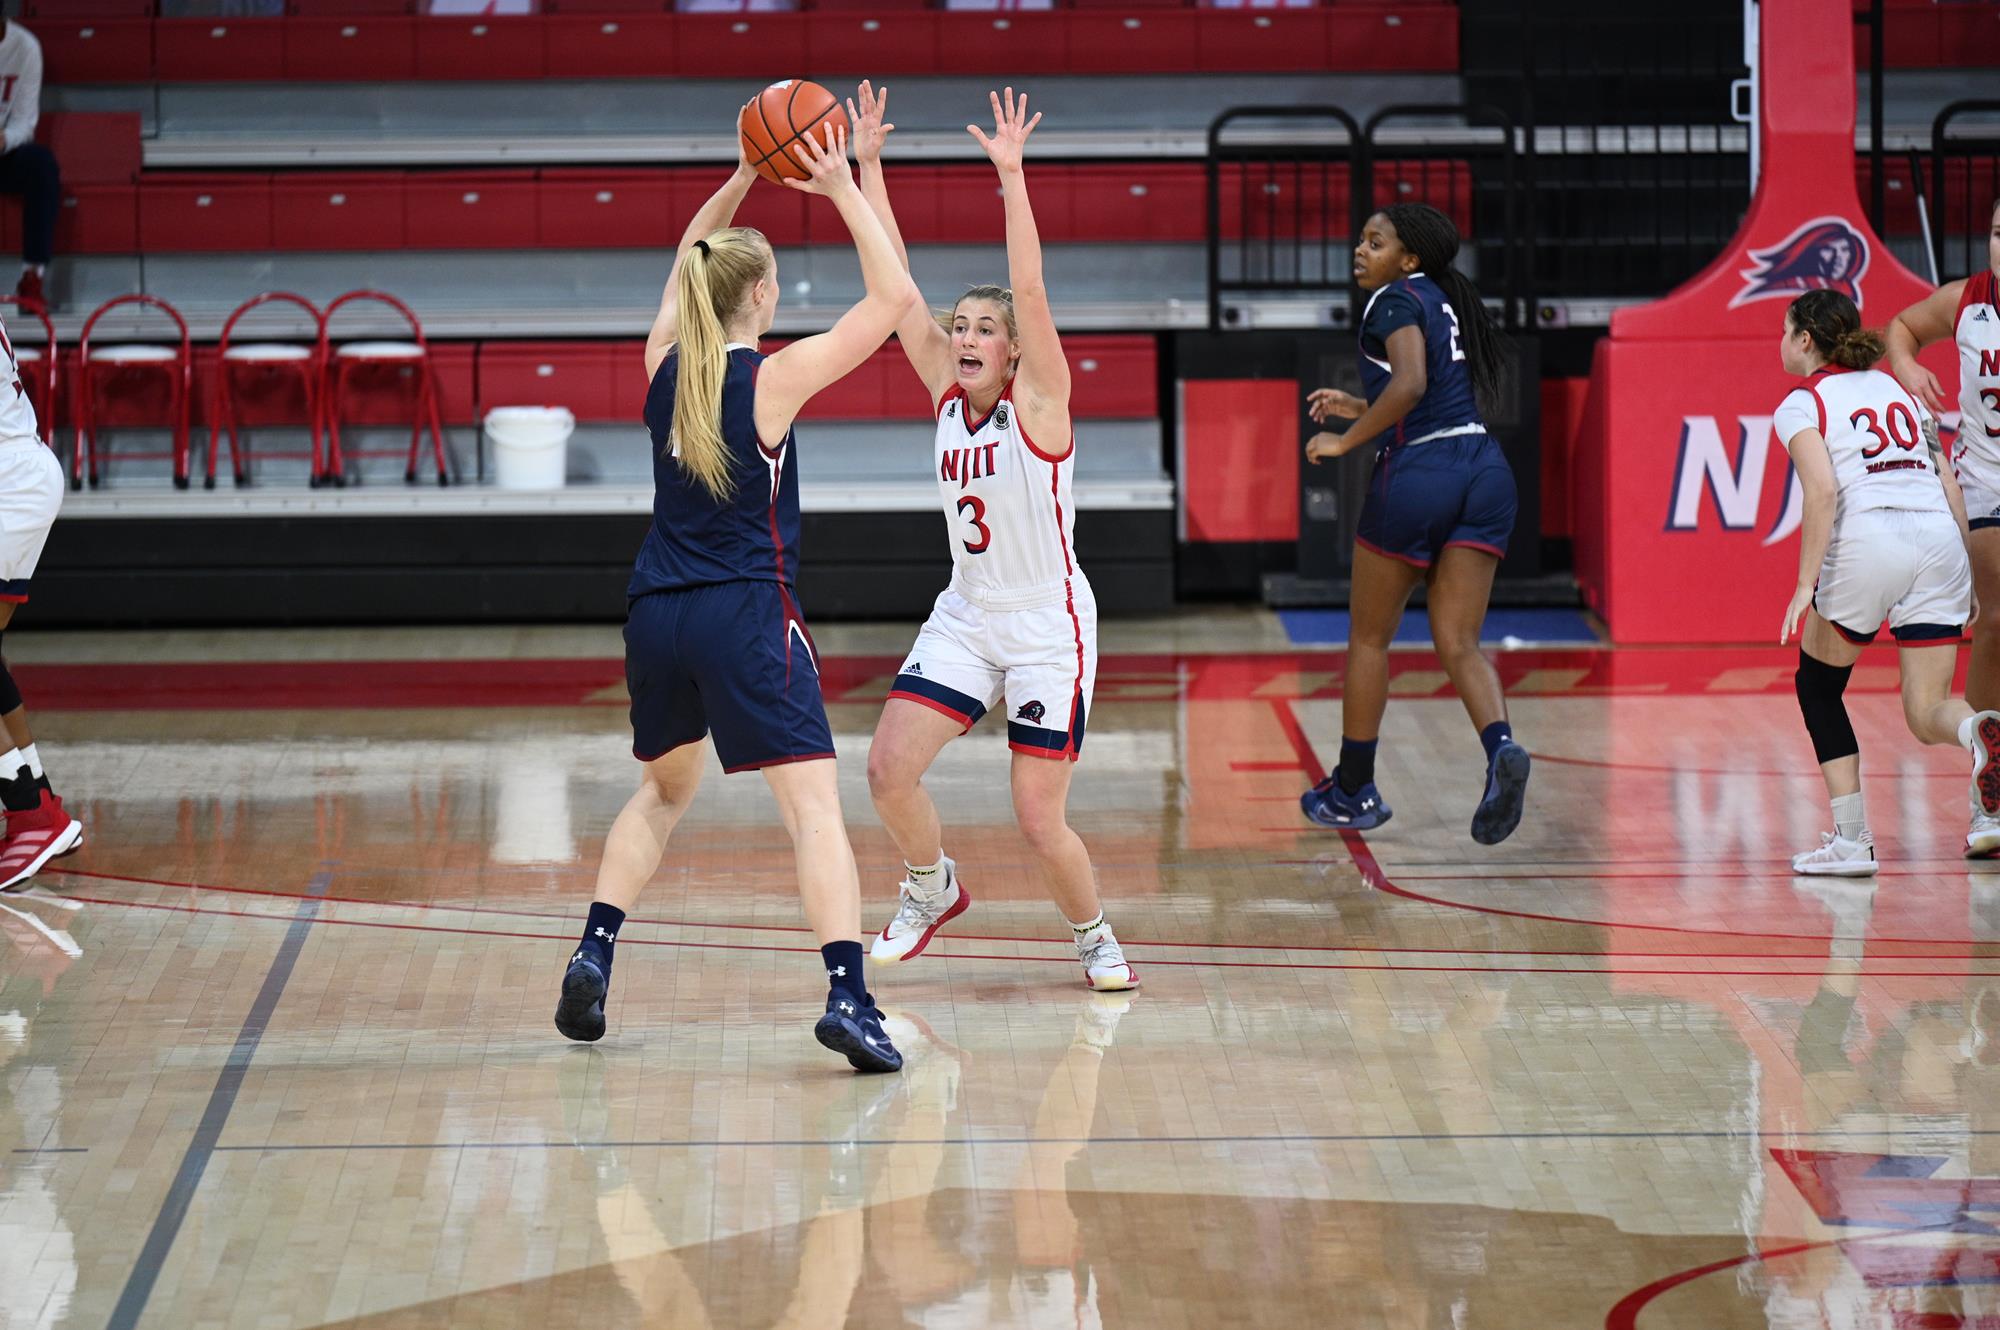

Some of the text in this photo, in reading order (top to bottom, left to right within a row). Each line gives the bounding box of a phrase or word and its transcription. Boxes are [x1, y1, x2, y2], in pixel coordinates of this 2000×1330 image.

[1850, 402, 1919, 459] 30
[941, 441, 999, 489] NJIT
[957, 495, 991, 554] 3
